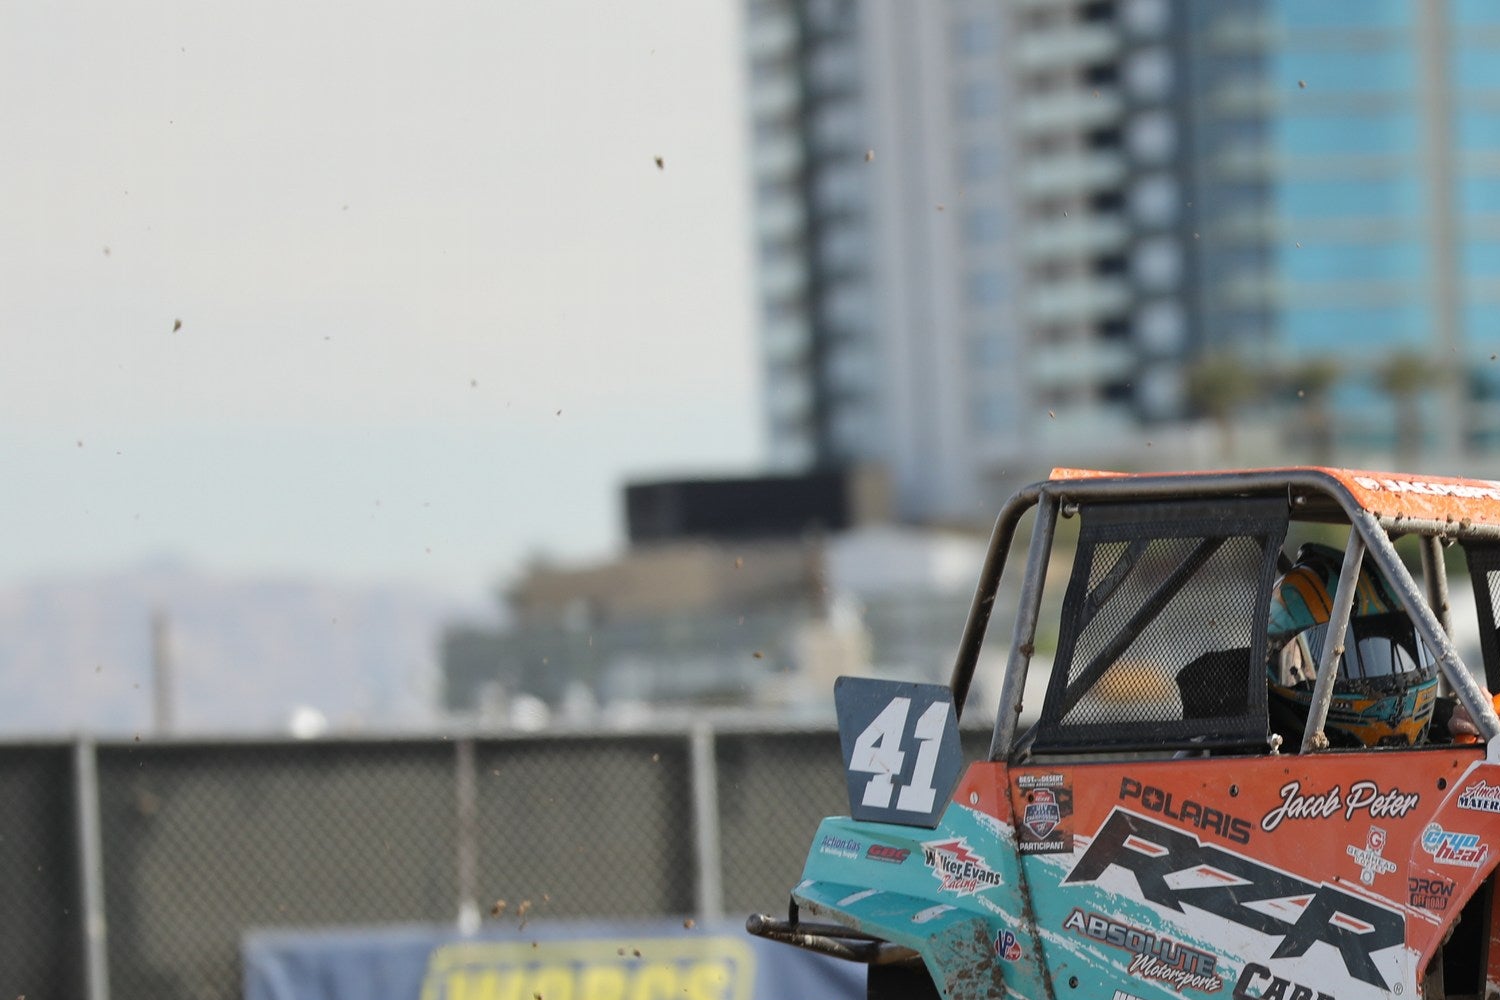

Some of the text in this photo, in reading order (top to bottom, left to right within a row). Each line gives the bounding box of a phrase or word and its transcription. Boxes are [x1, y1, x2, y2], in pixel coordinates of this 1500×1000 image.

[848, 697, 950, 814] 41
[1119, 777, 1251, 845] POLARIS
[1261, 780, 1420, 832] Jacob Peter
[1020, 841, 1064, 850] PARTICIPANT
[1424, 830, 1479, 852] cryo
[1435, 839, 1488, 862] heat
[925, 849, 963, 876] Wlker
[963, 861, 1000, 885] Evans
[937, 874, 978, 893] Racing
[1063, 808, 1406, 992] RZR
[1065, 908, 1217, 978] ABSOLUTE
[1129, 953, 1222, 992] Motorsports
